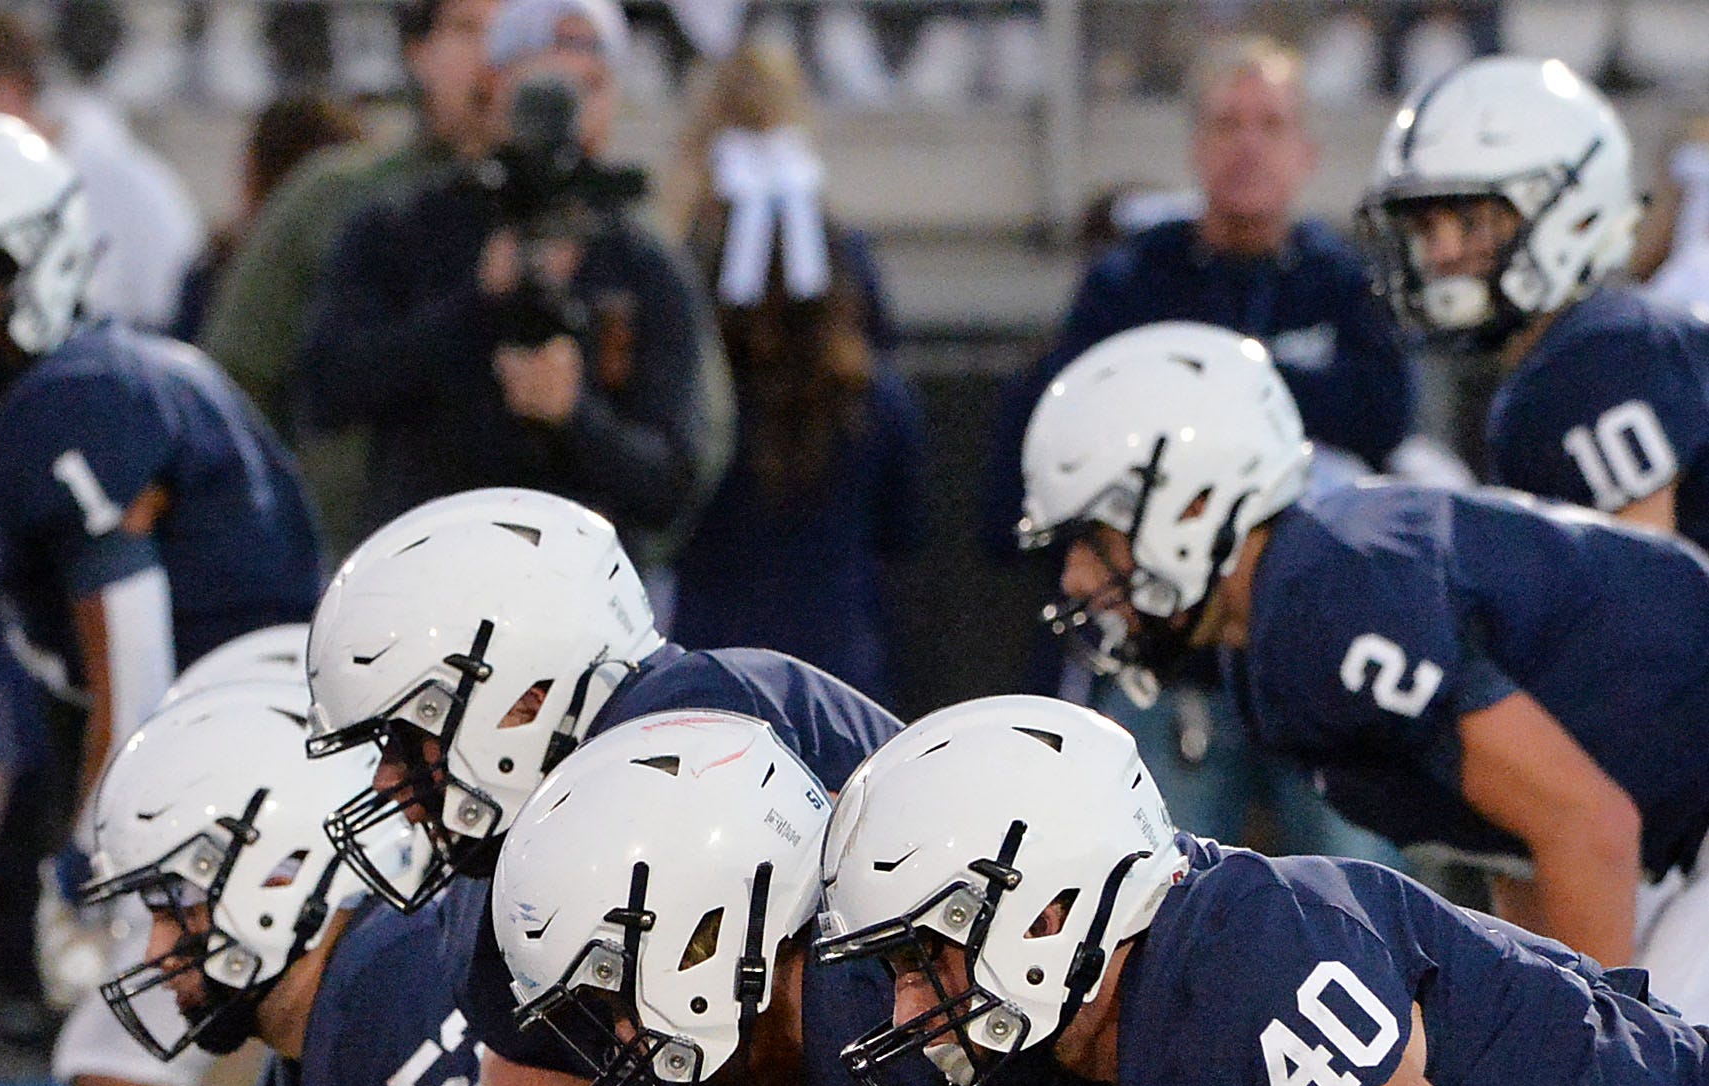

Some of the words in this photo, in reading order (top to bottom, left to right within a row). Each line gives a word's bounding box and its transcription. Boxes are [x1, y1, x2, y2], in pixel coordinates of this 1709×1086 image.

[53, 449, 122, 537] 1
[1561, 399, 1678, 513] 10
[1339, 632, 1444, 719] 2
